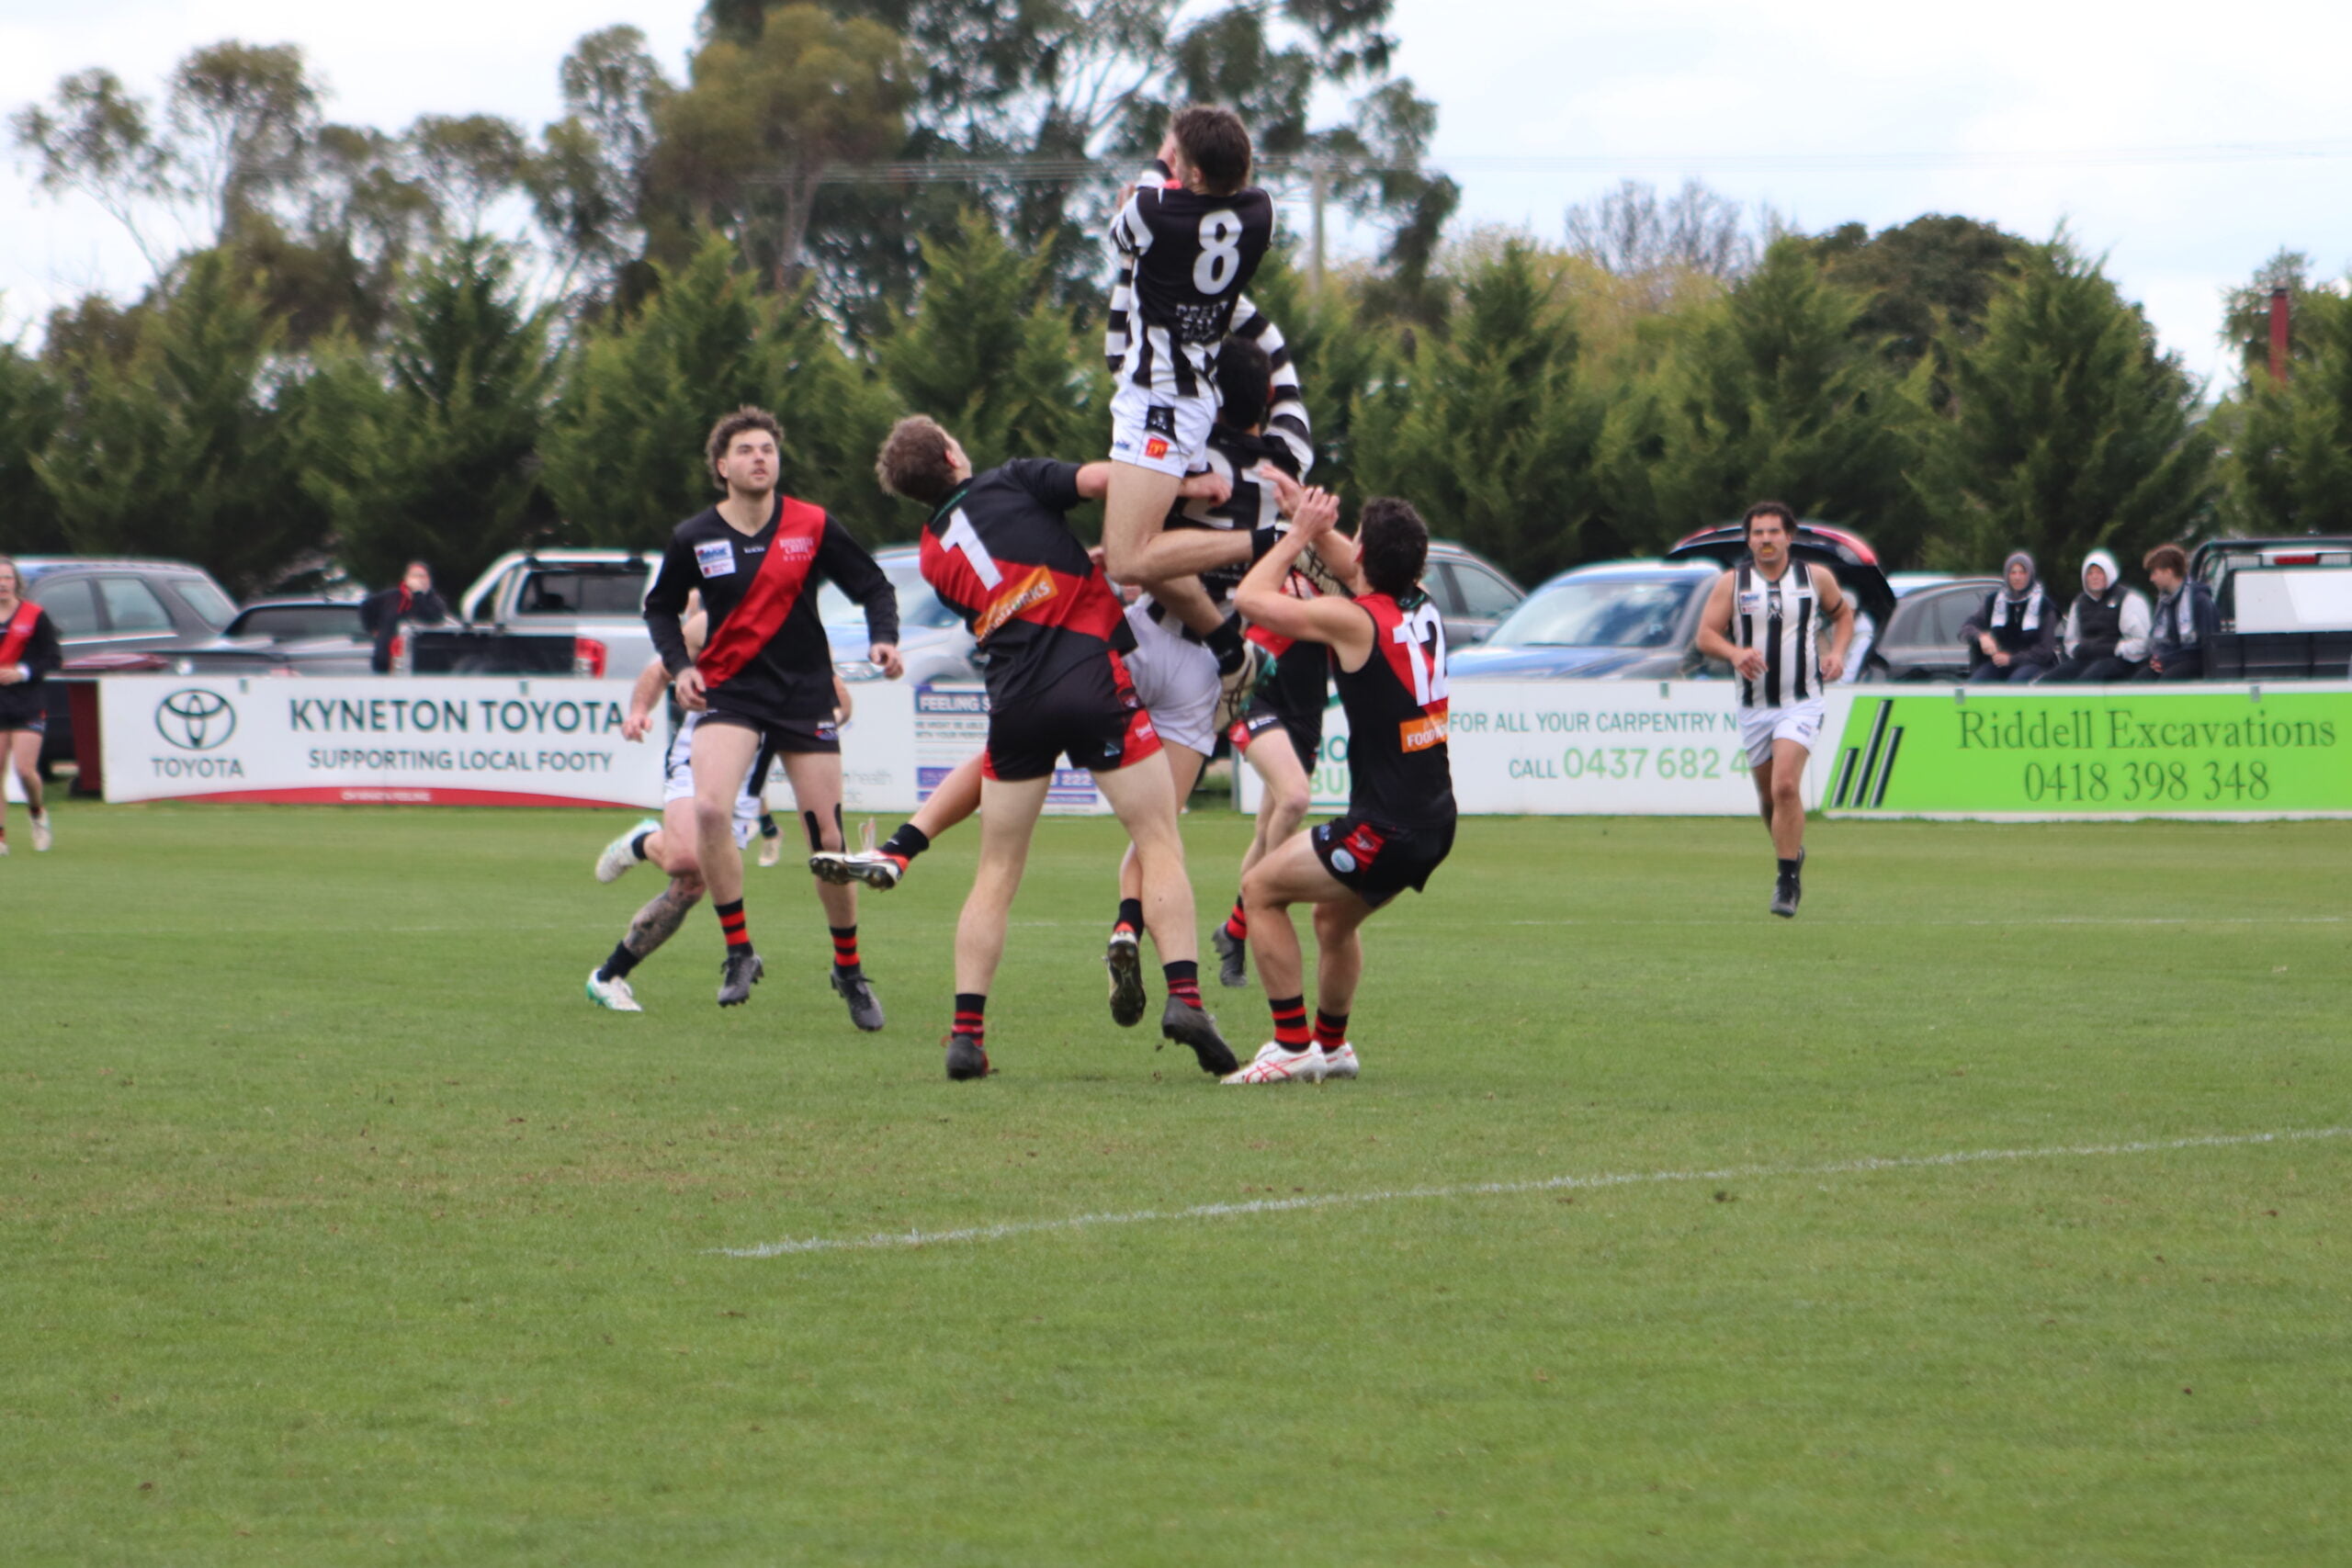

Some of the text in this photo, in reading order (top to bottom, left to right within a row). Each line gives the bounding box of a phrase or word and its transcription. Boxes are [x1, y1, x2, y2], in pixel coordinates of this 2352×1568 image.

[1193, 209, 1243, 295] 8
[940, 507, 1003, 592] 1
[1392, 602, 1449, 706] 12
[288, 698, 625, 735] KYNETON TOYOTA
[920, 694, 980, 712] FEELING
[1449, 713, 1487, 732] FOR
[1495, 713, 1531, 732] ALL
[1535, 713, 1590, 732] YOUR
[1596, 713, 1716, 732] CARPENTRY
[1957, 709, 2336, 750] Riddell Excavations
[151, 758, 245, 779] TOYOTA
[309, 749, 613, 773] SUPPORTING LOCAL FOOTY
[1509, 759, 1558, 779] CALL
[1564, 747, 1649, 780] 0437
[1657, 747, 1721, 780] 682
[2024, 761, 2270, 802] 0418 398 348
